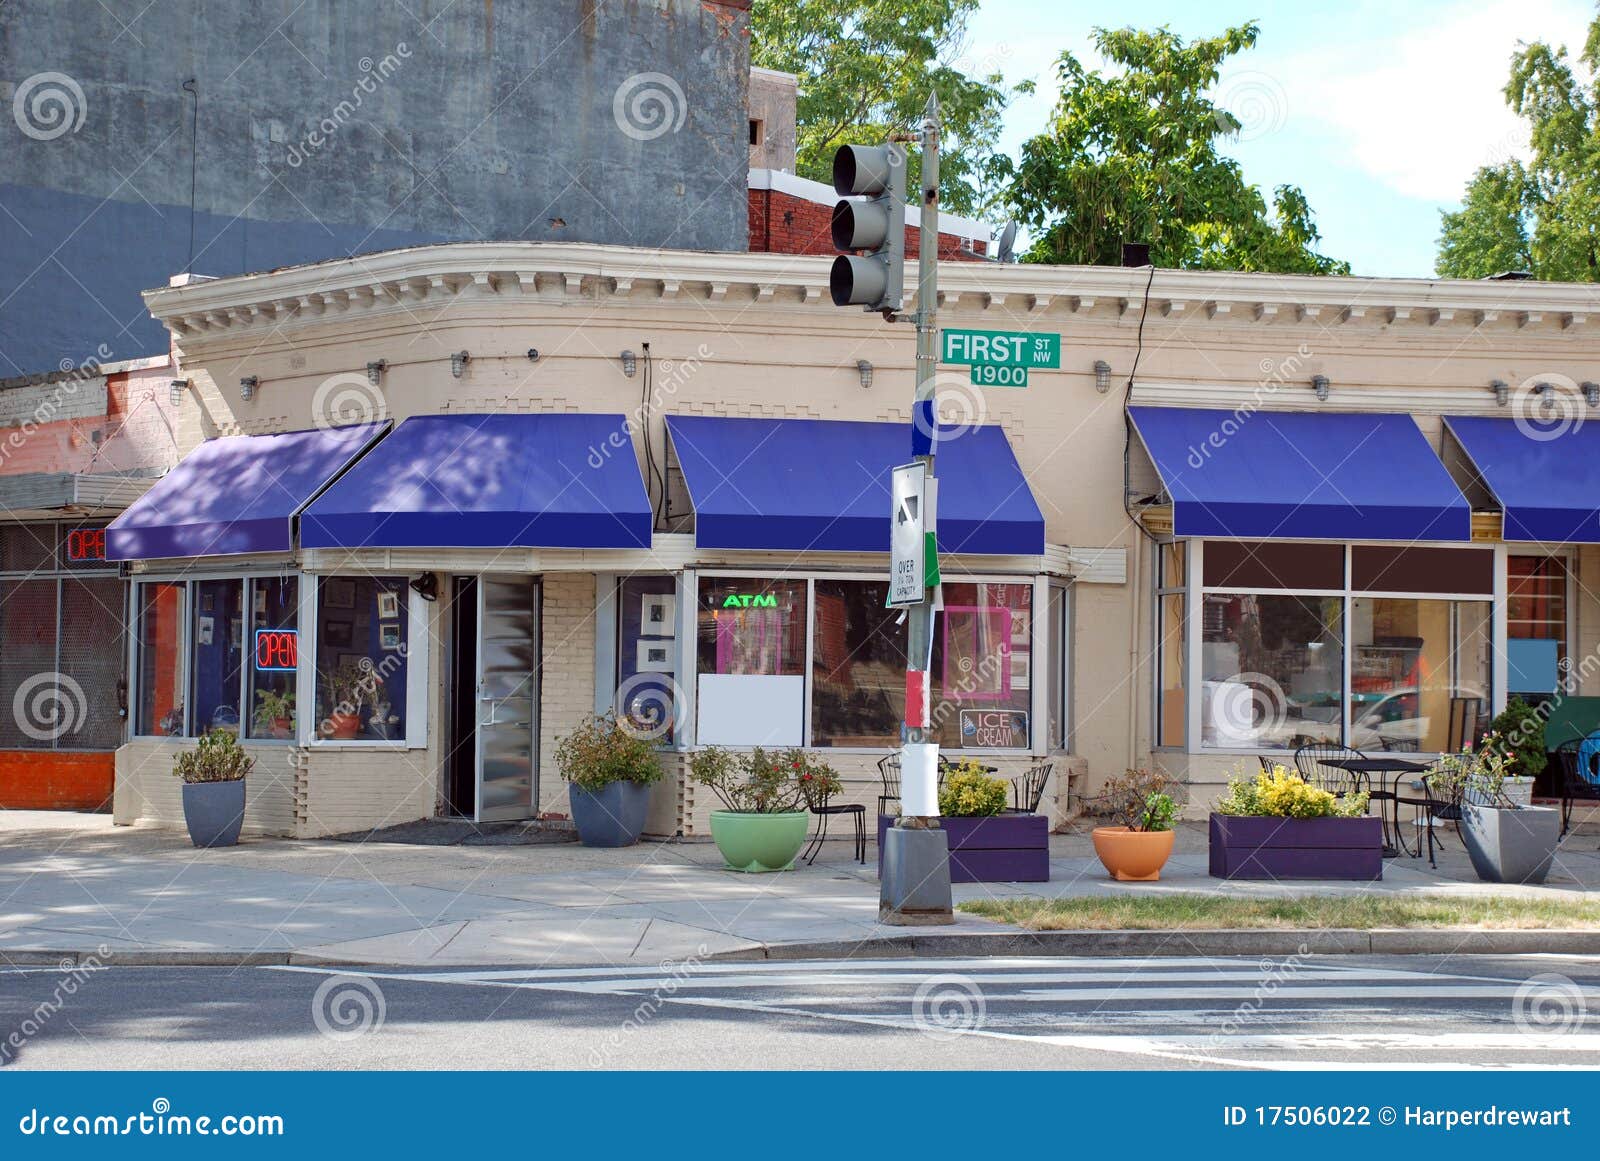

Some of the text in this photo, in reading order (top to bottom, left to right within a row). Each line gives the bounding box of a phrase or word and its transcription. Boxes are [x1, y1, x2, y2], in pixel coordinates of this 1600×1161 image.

[947, 334, 1051, 362] FIRST ST
[1033, 351, 1051, 362] NW
[973, 366, 1026, 385] 1900
[68, 530, 106, 560] OPE
[898, 559, 914, 574] OVER
[723, 594, 778, 608] ATM
[258, 633, 298, 667] OPEN
[978, 713, 1011, 728] ICE
[976, 727, 1014, 746] CREAM
